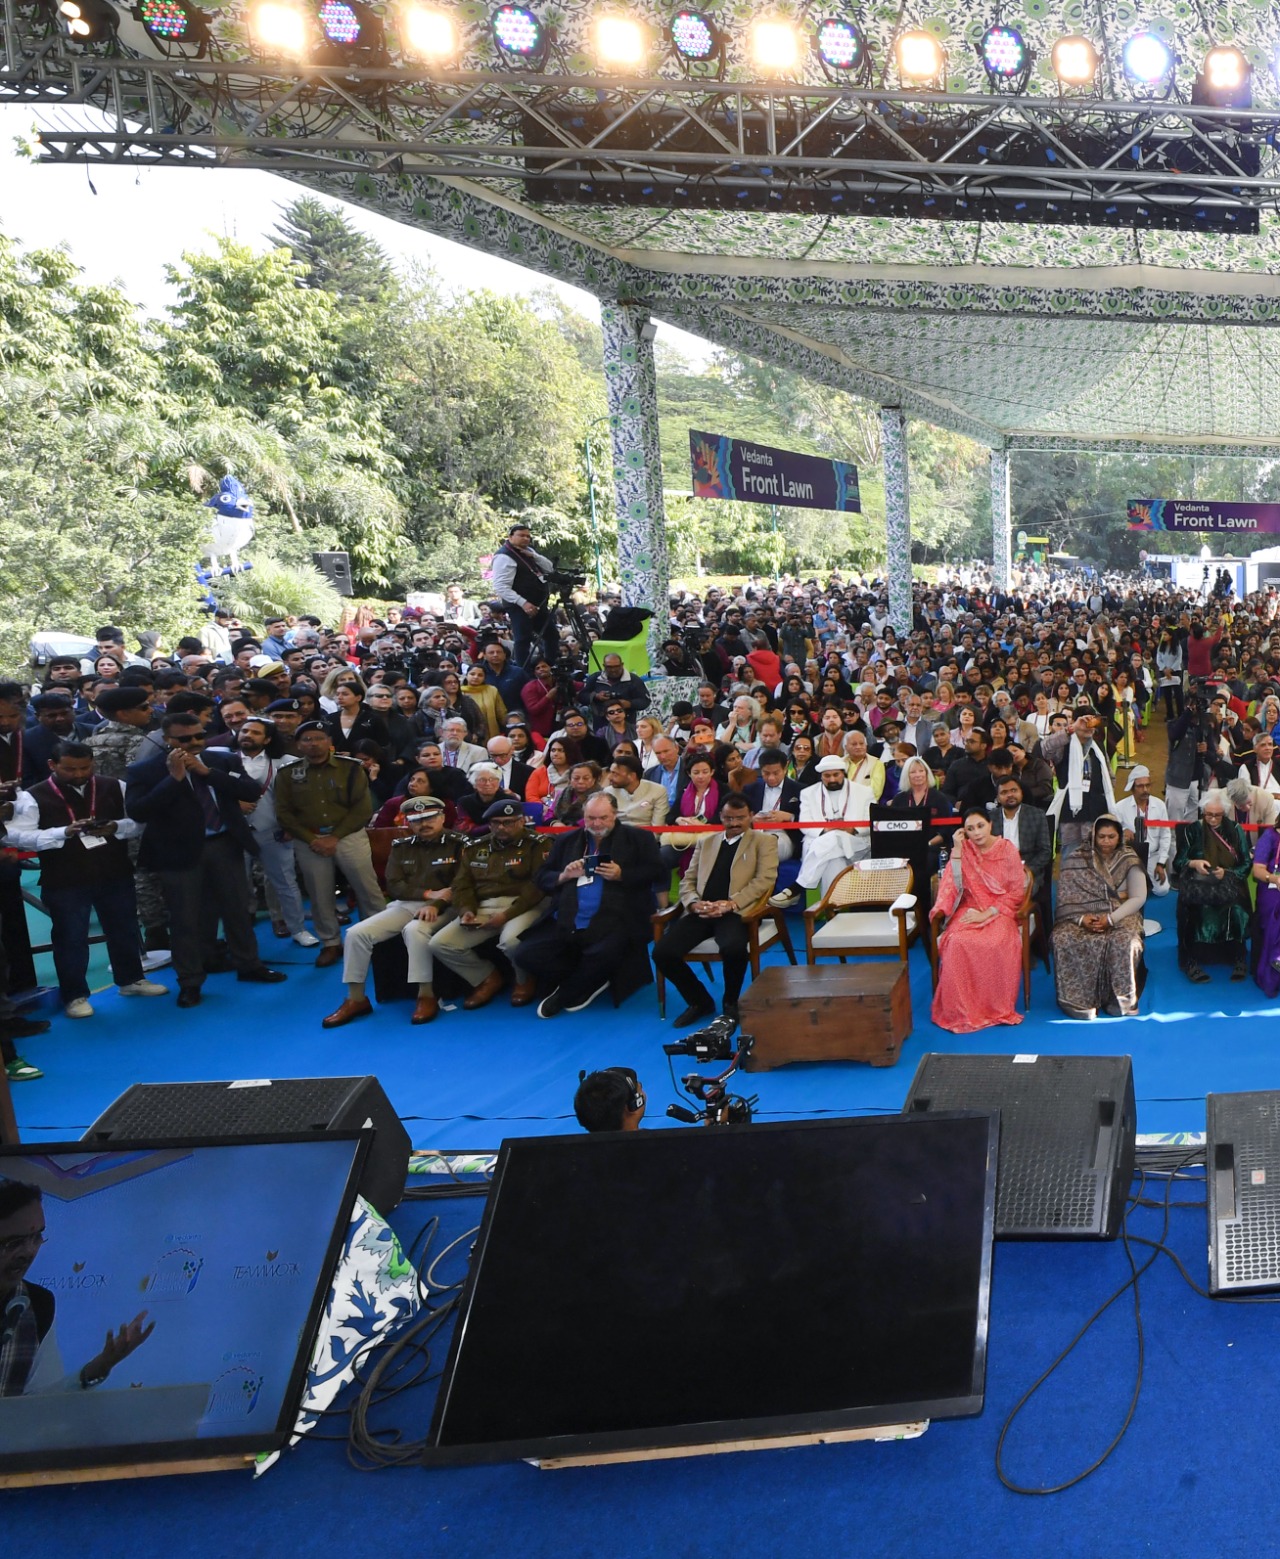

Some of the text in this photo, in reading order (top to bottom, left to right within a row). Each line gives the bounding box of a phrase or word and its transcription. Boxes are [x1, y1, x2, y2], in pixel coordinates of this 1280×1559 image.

[740, 446, 773, 467] Vedanta
[742, 466, 779, 497] Front
[781, 473, 814, 500] Lawn
[1174, 503, 1210, 512] Vedanta
[1174, 513, 1258, 528] Front Lawn
[887, 822, 908, 830] CMO
[232, 1263, 302, 1280] TEAMWORK
[38, 1274, 109, 1290] TEAMWORK
